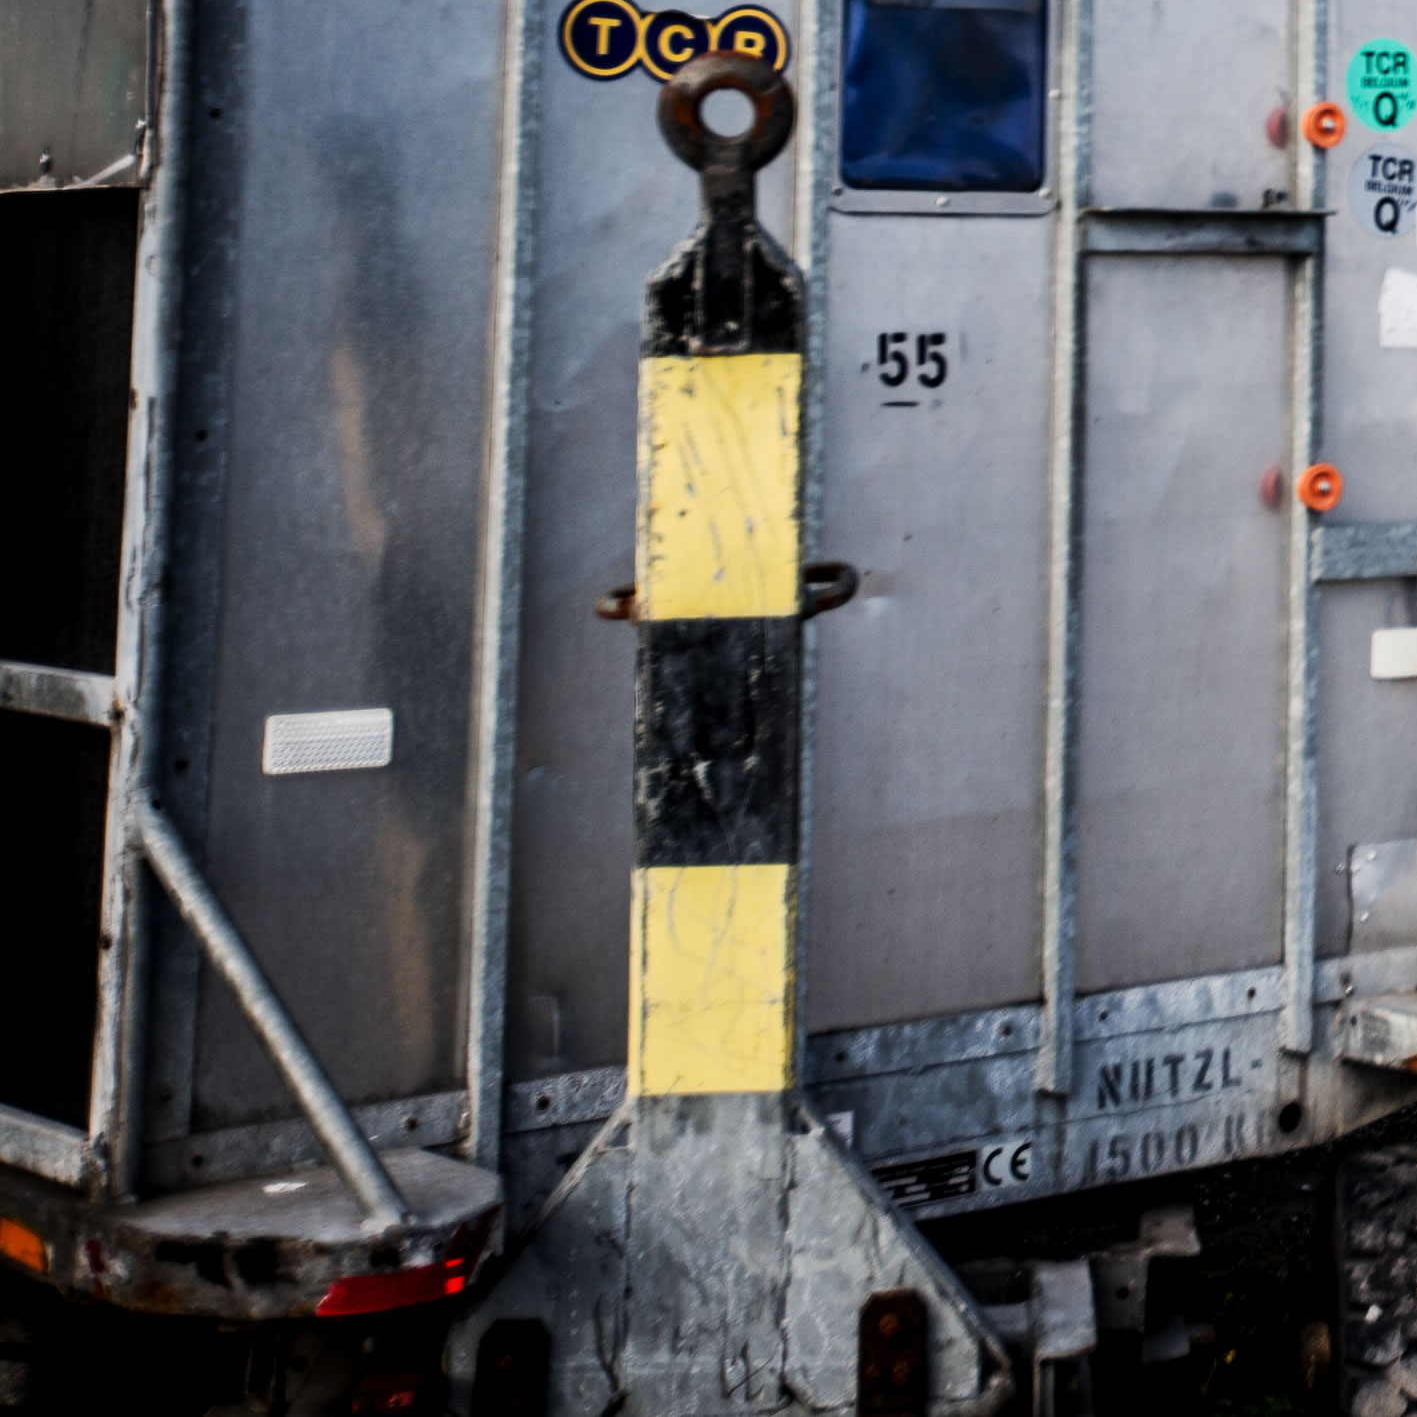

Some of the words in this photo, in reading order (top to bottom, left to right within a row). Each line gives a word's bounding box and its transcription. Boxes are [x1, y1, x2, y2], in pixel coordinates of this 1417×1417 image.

[1360, 50, 1410, 76] TCR
[1373, 91, 1399, 128] Q
[1367, 153, 1416, 182] TCR
[1373, 196, 1399, 234] Q
[877, 331, 948, 389] 55
